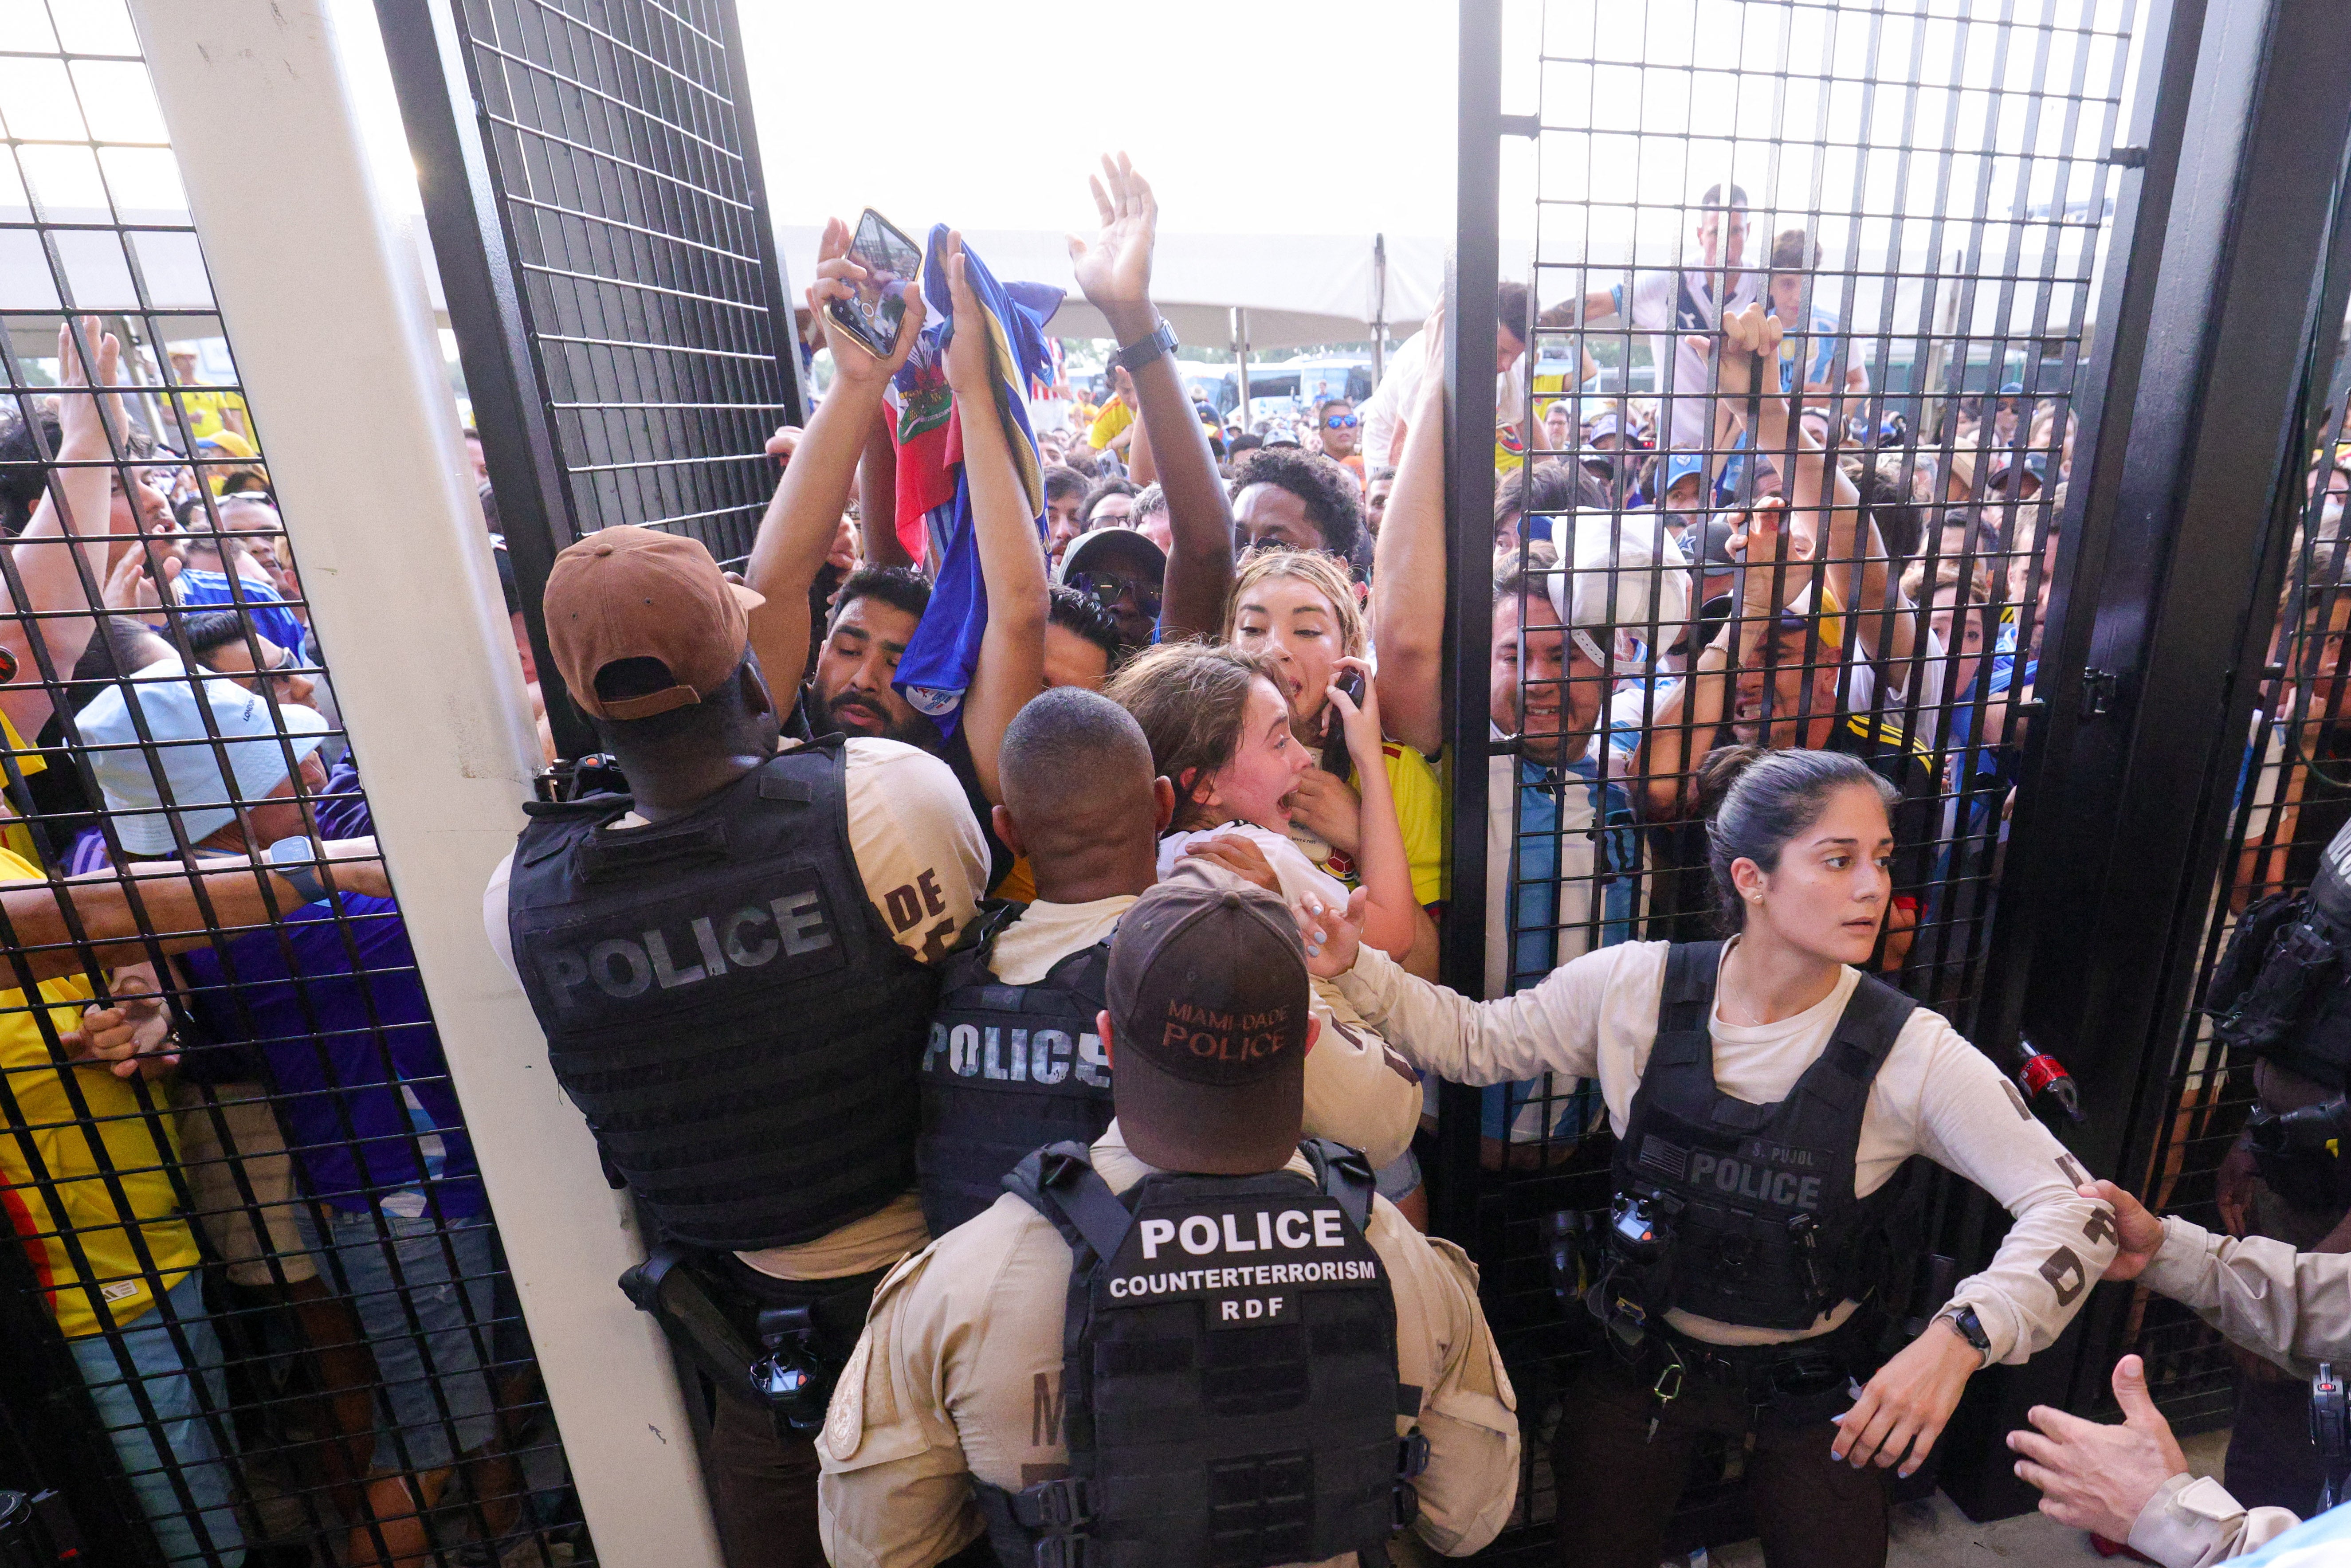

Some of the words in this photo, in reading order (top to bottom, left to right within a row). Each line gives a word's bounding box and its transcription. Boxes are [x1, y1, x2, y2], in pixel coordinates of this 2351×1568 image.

[243, 698, 255, 722] LONDON
[541, 890, 833, 1008] POLICE
[1168, 998, 1288, 1031] MIAMI-DADE
[922, 1022, 1111, 1088] POLICE
[1162, 1022, 1285, 1061] POLICE
[1772, 1146, 1813, 1166] PUJOL
[1690, 1153, 1821, 1210] POLICE
[1140, 1209, 1345, 1259] POLICE
[1110, 1260, 1376, 1298] COUNTERTERRORISM
